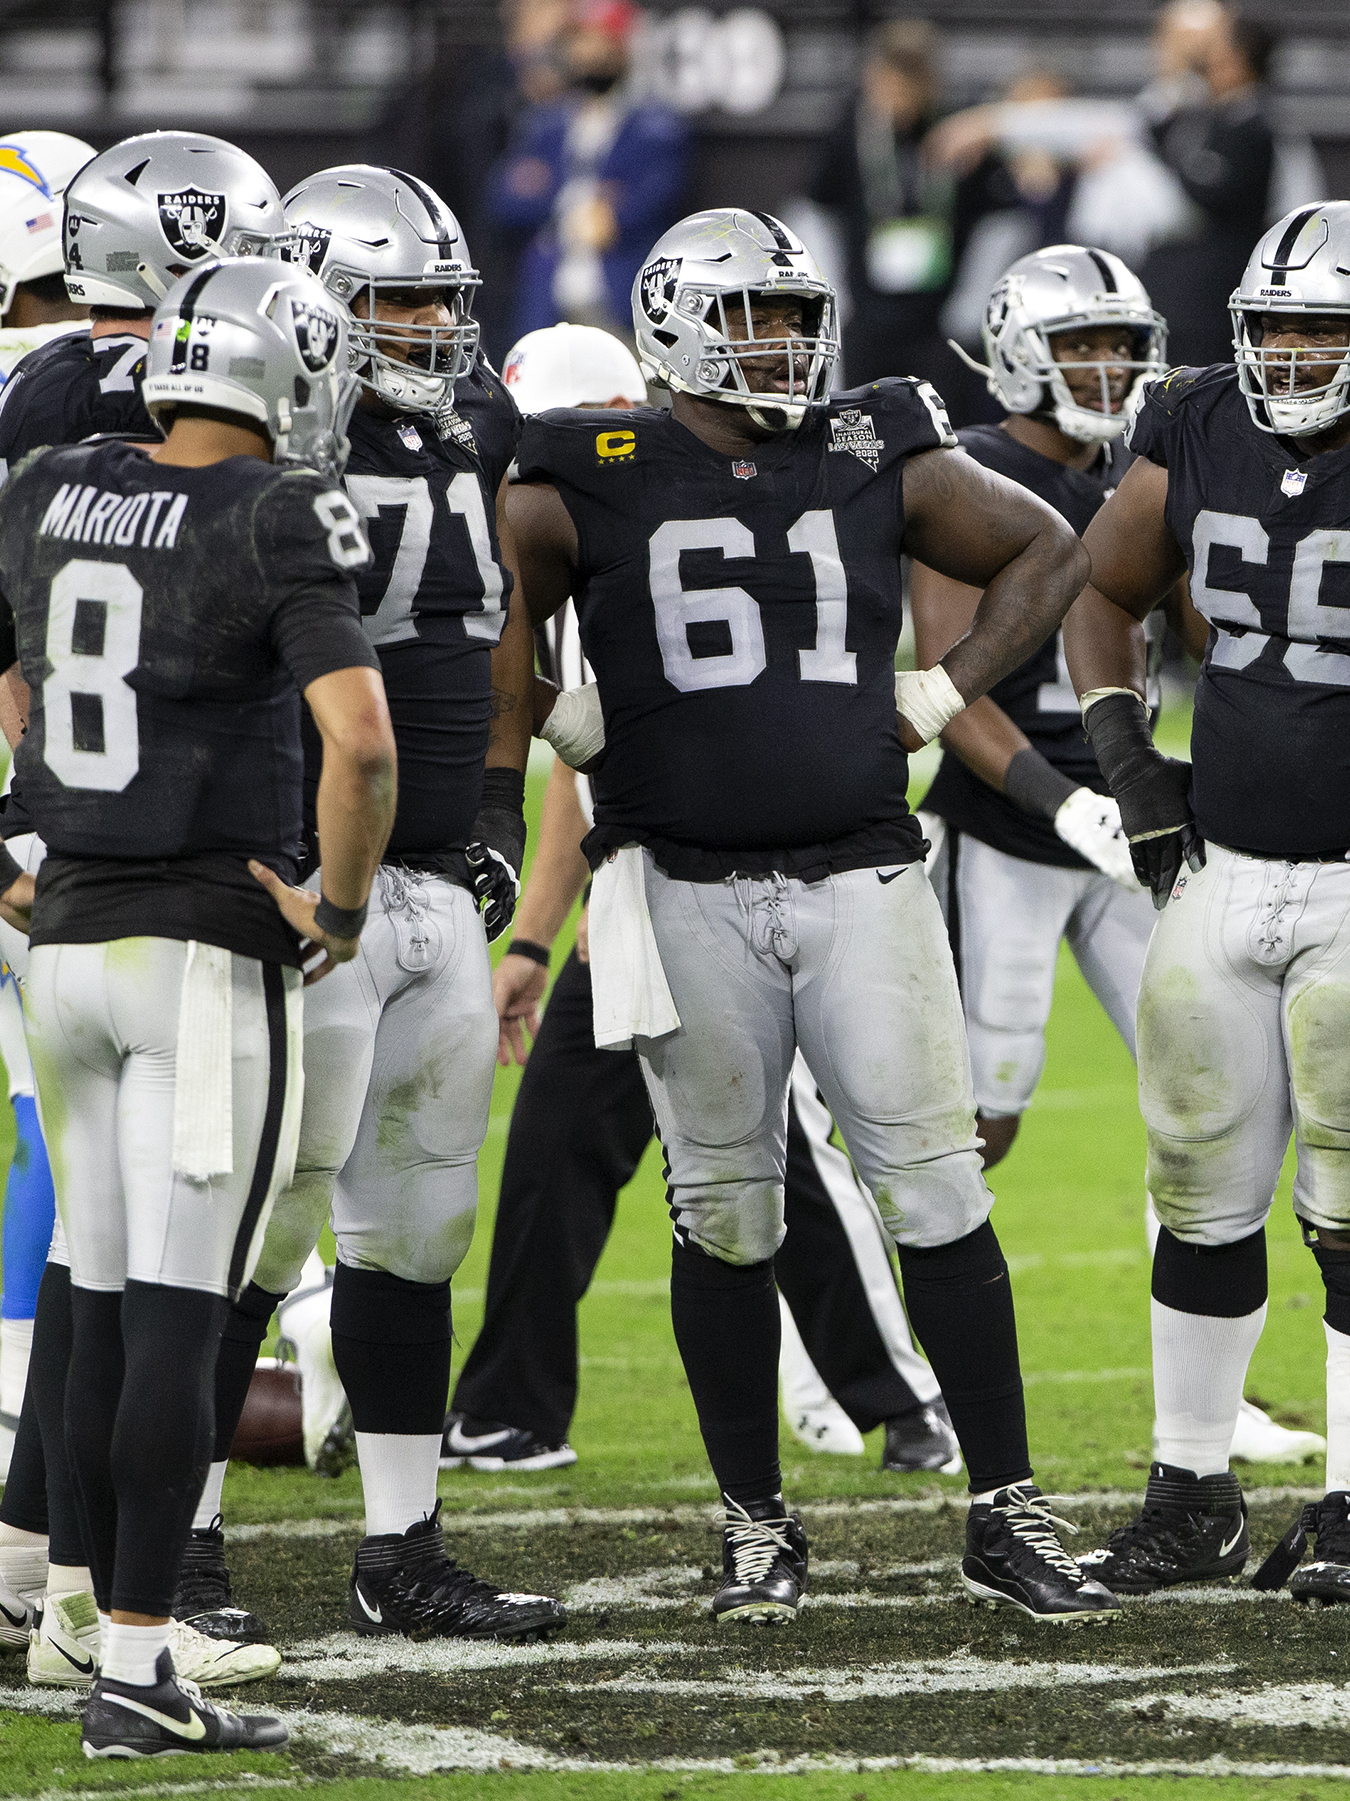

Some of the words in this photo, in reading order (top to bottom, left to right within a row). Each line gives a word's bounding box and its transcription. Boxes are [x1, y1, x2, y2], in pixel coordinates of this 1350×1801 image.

[163, 194, 221, 206] RAIDERS
[434, 263, 463, 273] RAIDERS
[644, 259, 679, 276] RAIDERS
[1260, 288, 1293, 298] RAIDERS
[190, 342, 210, 372] 8
[596, 430, 636, 458] C
[836, 434, 873, 443] SEASON
[855, 449, 879, 458] 2020
[39, 483, 189, 549] MARIOTA
[313, 490, 370, 569] 8
[344, 473, 506, 648] 71
[648, 509, 858, 692] 61
[43, 558, 144, 793] 8
